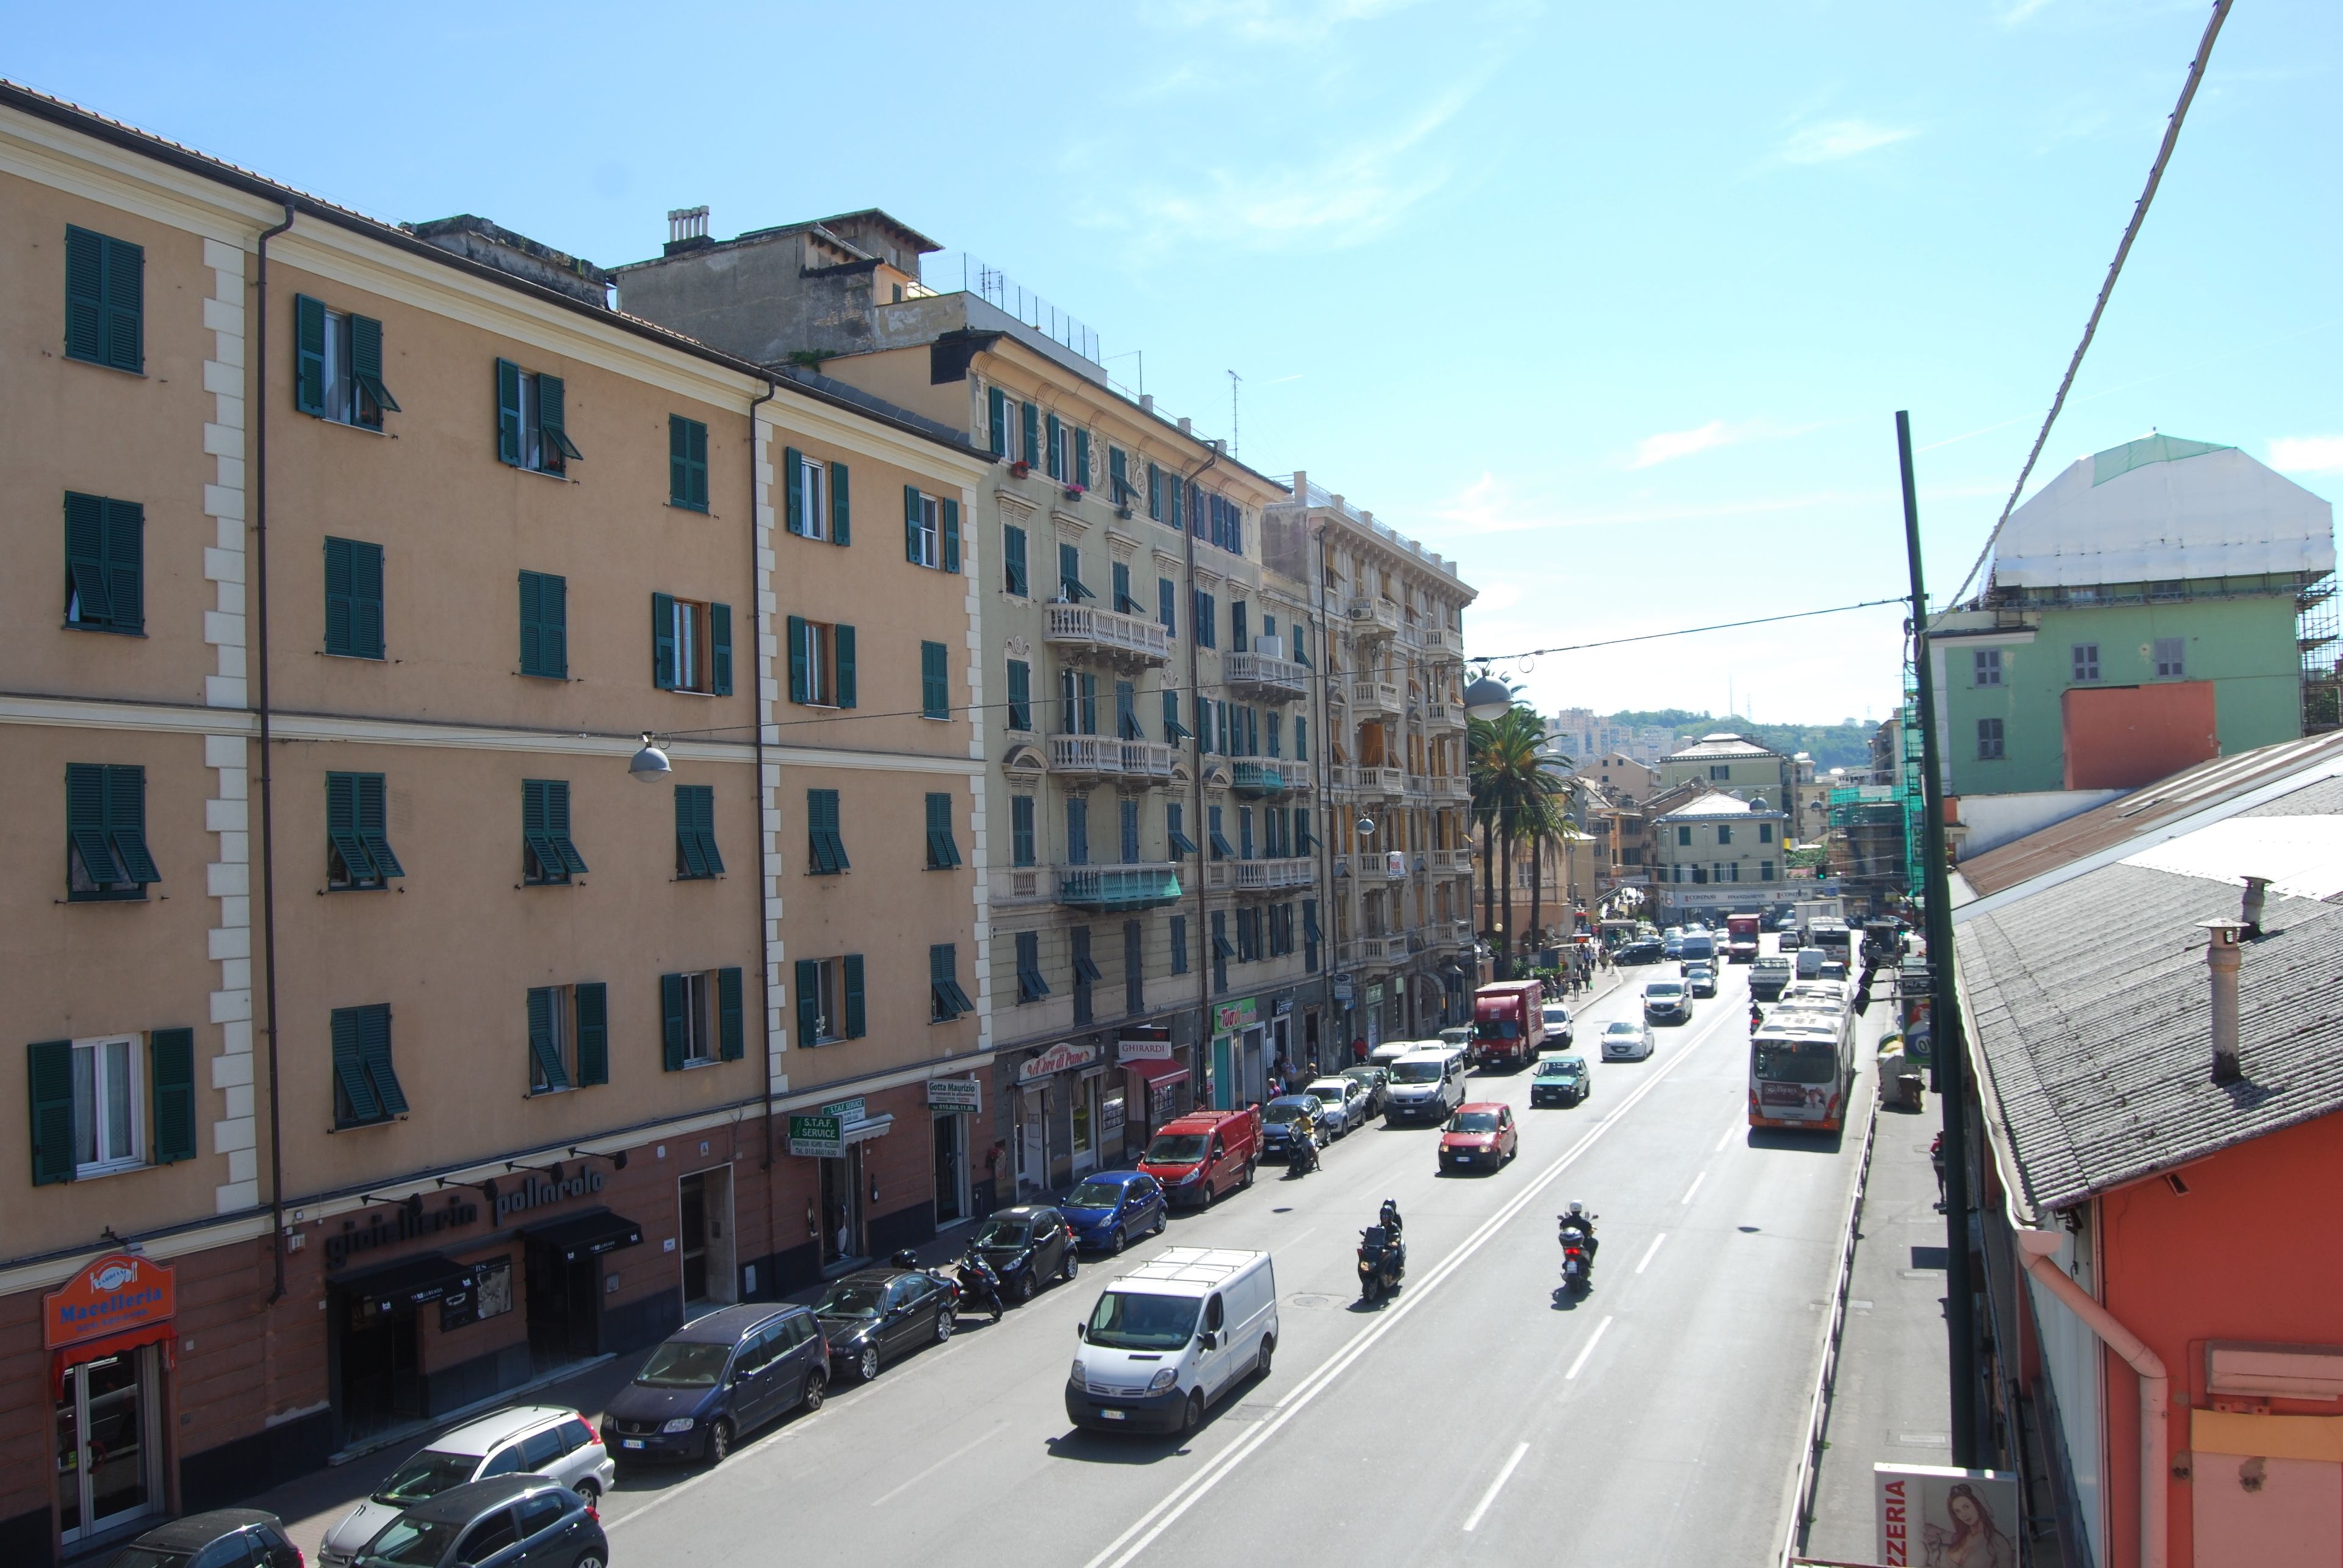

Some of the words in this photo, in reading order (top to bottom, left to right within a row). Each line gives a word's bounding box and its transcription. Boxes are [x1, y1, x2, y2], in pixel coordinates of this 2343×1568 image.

[929, 1082, 946, 1091] Gotta
[948, 1084, 975, 1092] Maurizio
[846, 1099, 863, 1110] SERVICE
[804, 1118, 832, 1127] S.T.A.F.
[802, 1128, 835, 1138] SERVICE
[494, 1165, 605, 1226] pollarolo
[60, 1287, 162, 1323] Macelleria
